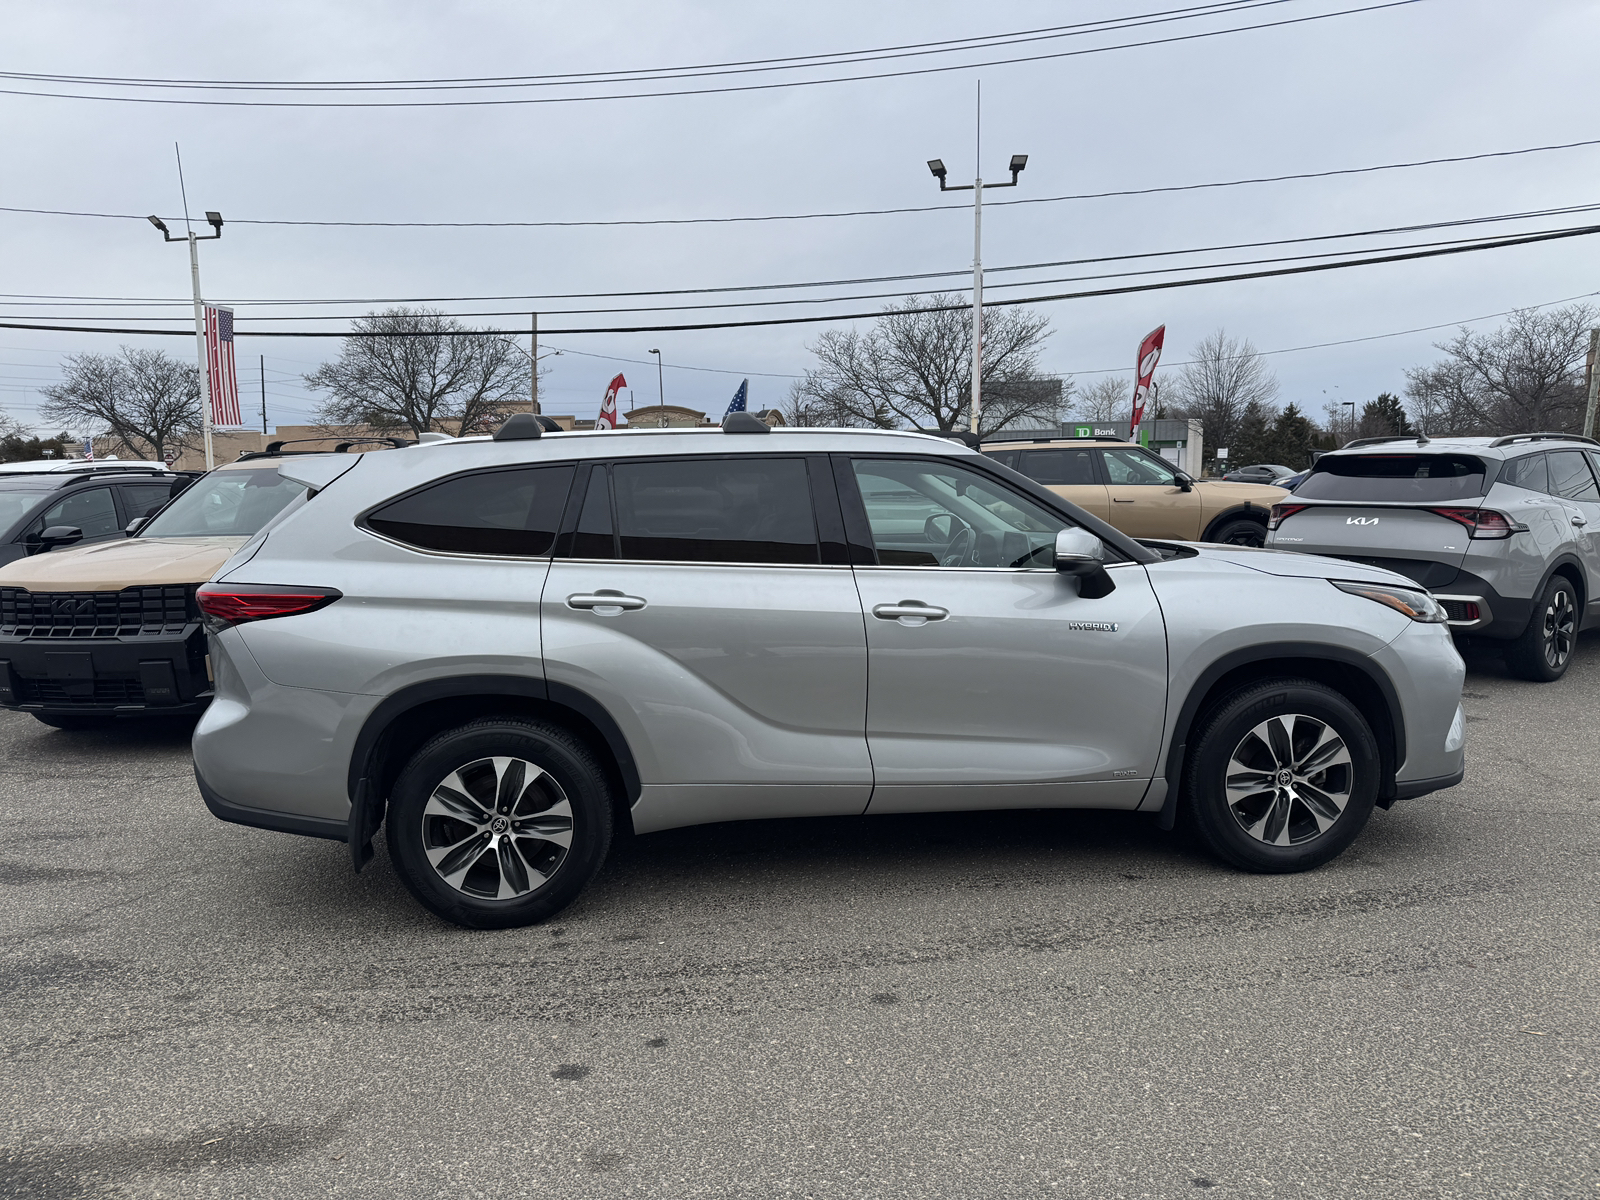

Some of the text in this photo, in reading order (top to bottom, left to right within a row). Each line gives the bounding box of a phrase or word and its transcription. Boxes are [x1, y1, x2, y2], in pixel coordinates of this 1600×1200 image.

[1076, 427, 1116, 437] TD Bank
[1346, 516, 1380, 526] KIA
[51, 599, 95, 615] KIA
[1069, 622, 1111, 631] HYBRID
